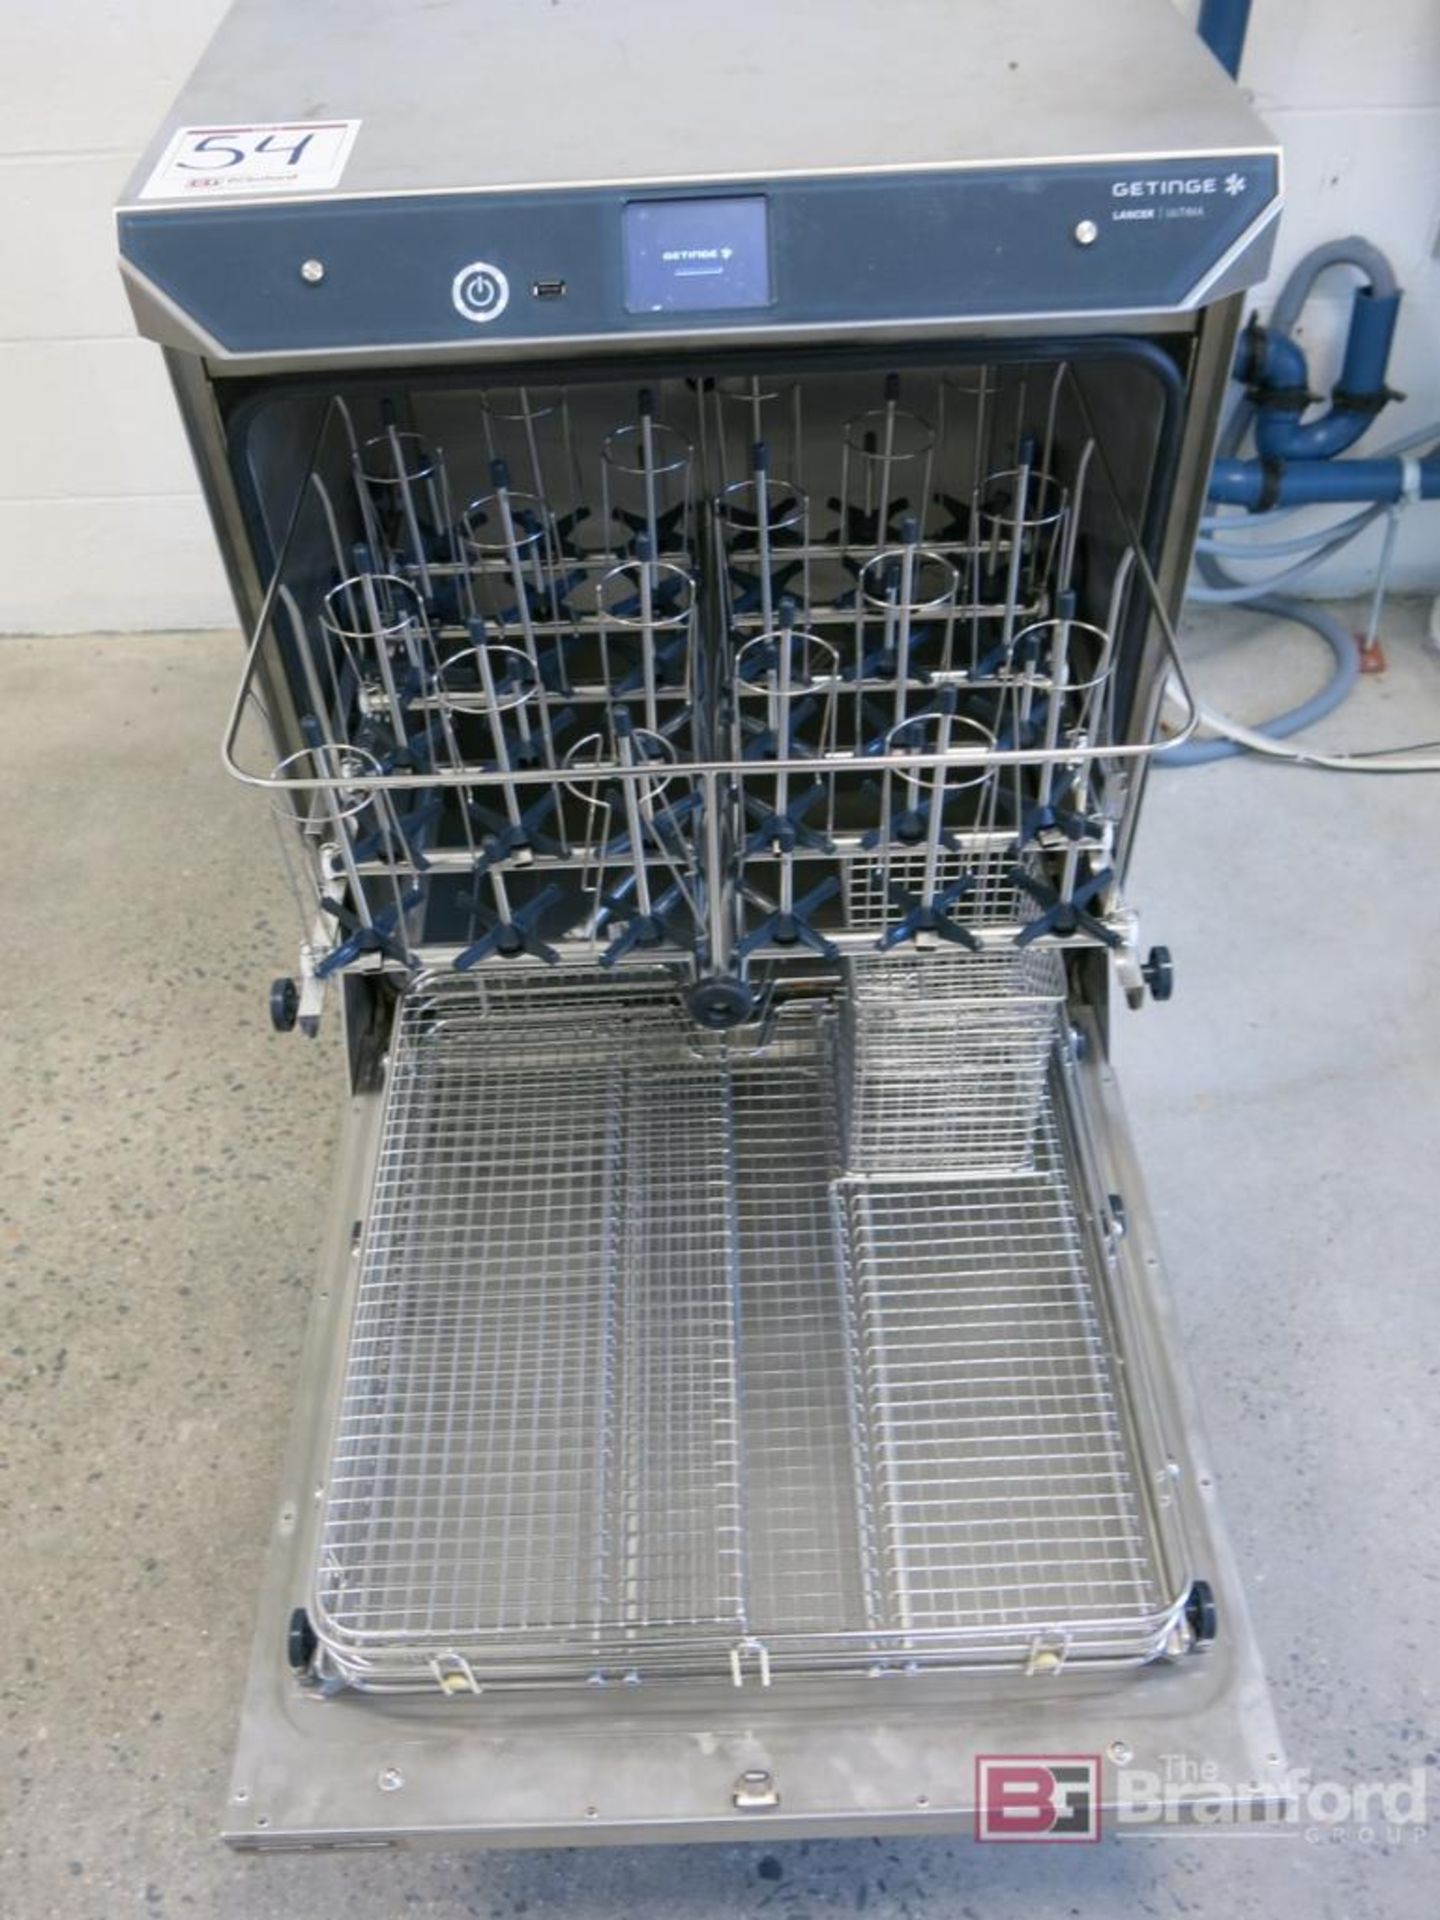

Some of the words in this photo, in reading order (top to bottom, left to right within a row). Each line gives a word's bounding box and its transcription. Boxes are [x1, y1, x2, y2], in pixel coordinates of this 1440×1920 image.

[176, 133, 314, 170] 54
[1112, 178, 1217, 197] GETINGE
[1112, 208, 1154, 221] LANCER
[662, 250, 718, 260] GETINGE
